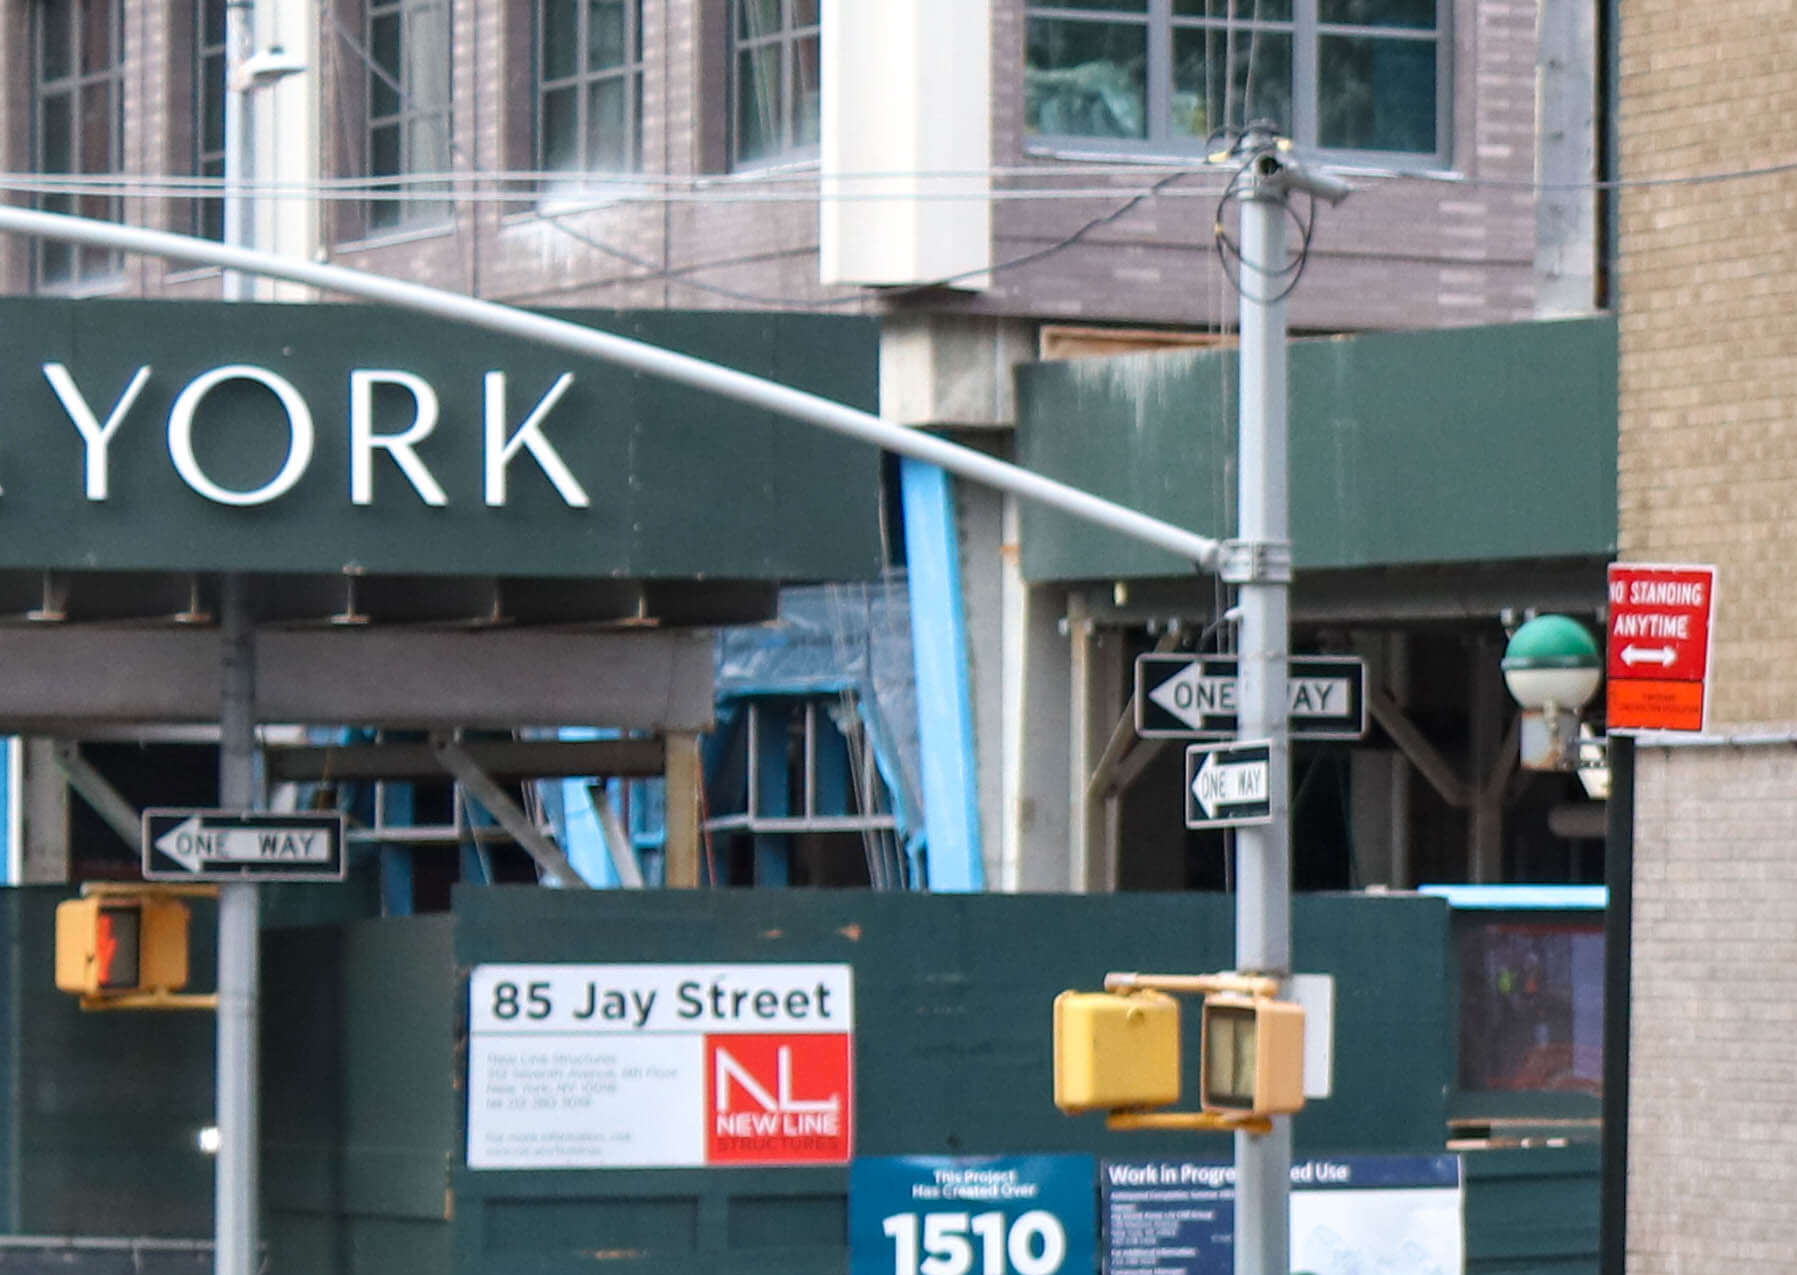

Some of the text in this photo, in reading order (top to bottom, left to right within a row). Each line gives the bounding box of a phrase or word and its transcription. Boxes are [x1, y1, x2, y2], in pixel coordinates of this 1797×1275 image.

[43, 362, 590, 509] YORK
[1609, 580, 1703, 606] NO STANDING
[1613, 614, 1690, 640] ANYTIME
[1173, 681, 1333, 711] ONE AY
[1202, 768, 1261, 799] ONE WAY
[175, 832, 317, 861] ONE WAY
[491, 979, 832, 1029] 85 Jay Street
[716, 1113, 838, 1136] NEW LINE
[934, 1169, 1018, 1186] This Project
[1108, 1163, 1158, 1185] Work
[1160, 1163, 1178, 1184] in
[1181, 1163, 1236, 1188] Progre
[1315, 1162, 1350, 1182] Use
[912, 1183, 1038, 1199] Has Created Over
